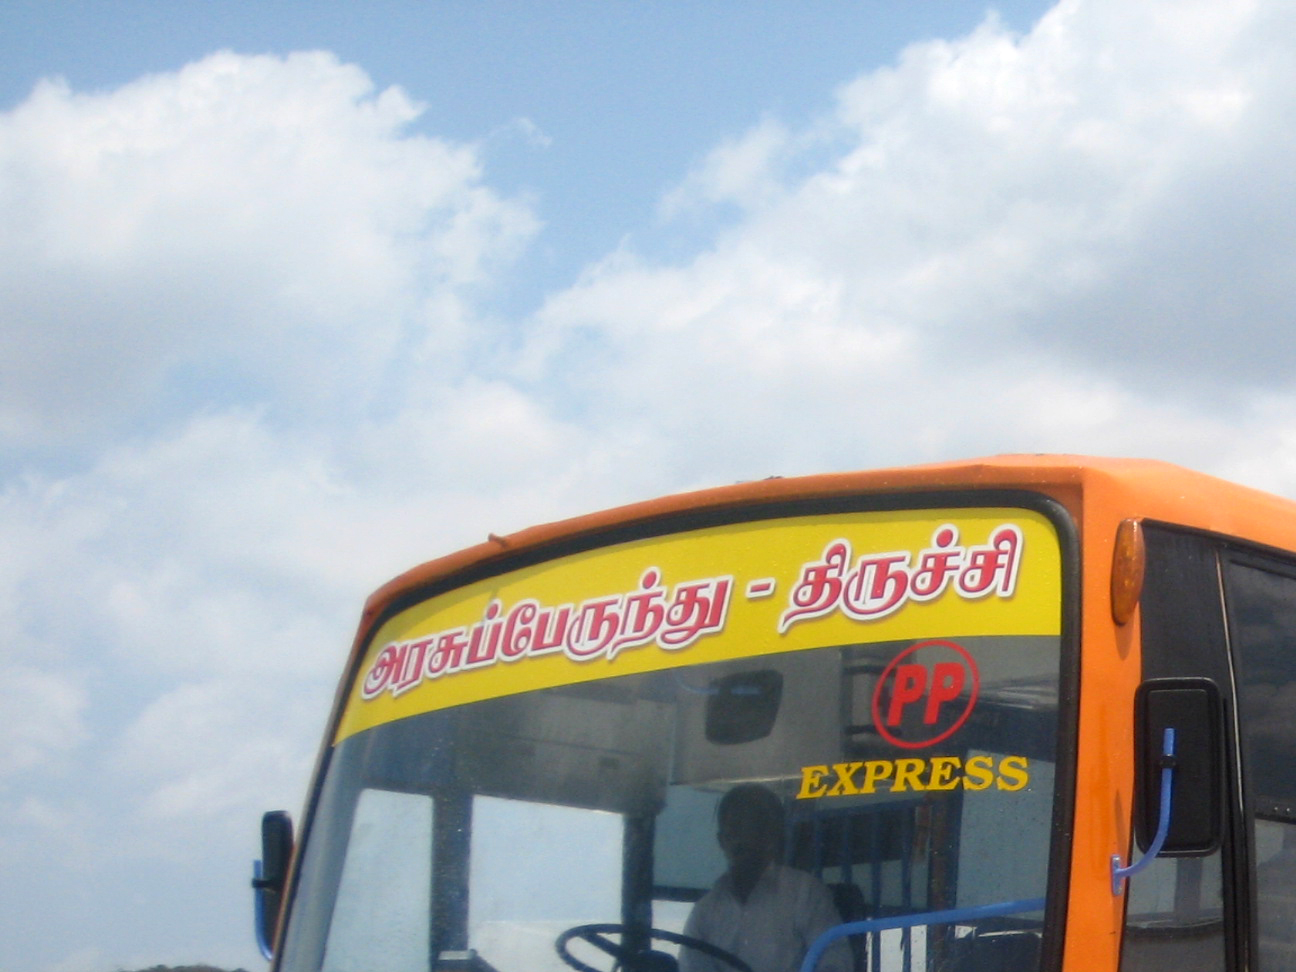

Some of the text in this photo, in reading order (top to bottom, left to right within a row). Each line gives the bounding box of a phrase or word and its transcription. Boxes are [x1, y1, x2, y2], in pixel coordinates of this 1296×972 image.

[362, 567, 732, 698] அரசுப்பேருந்து
[777, 524, 1023, 634] திருச்சி
[886, 662, 965, 726] PP
[796, 756, 1030, 799] EXPRESS
